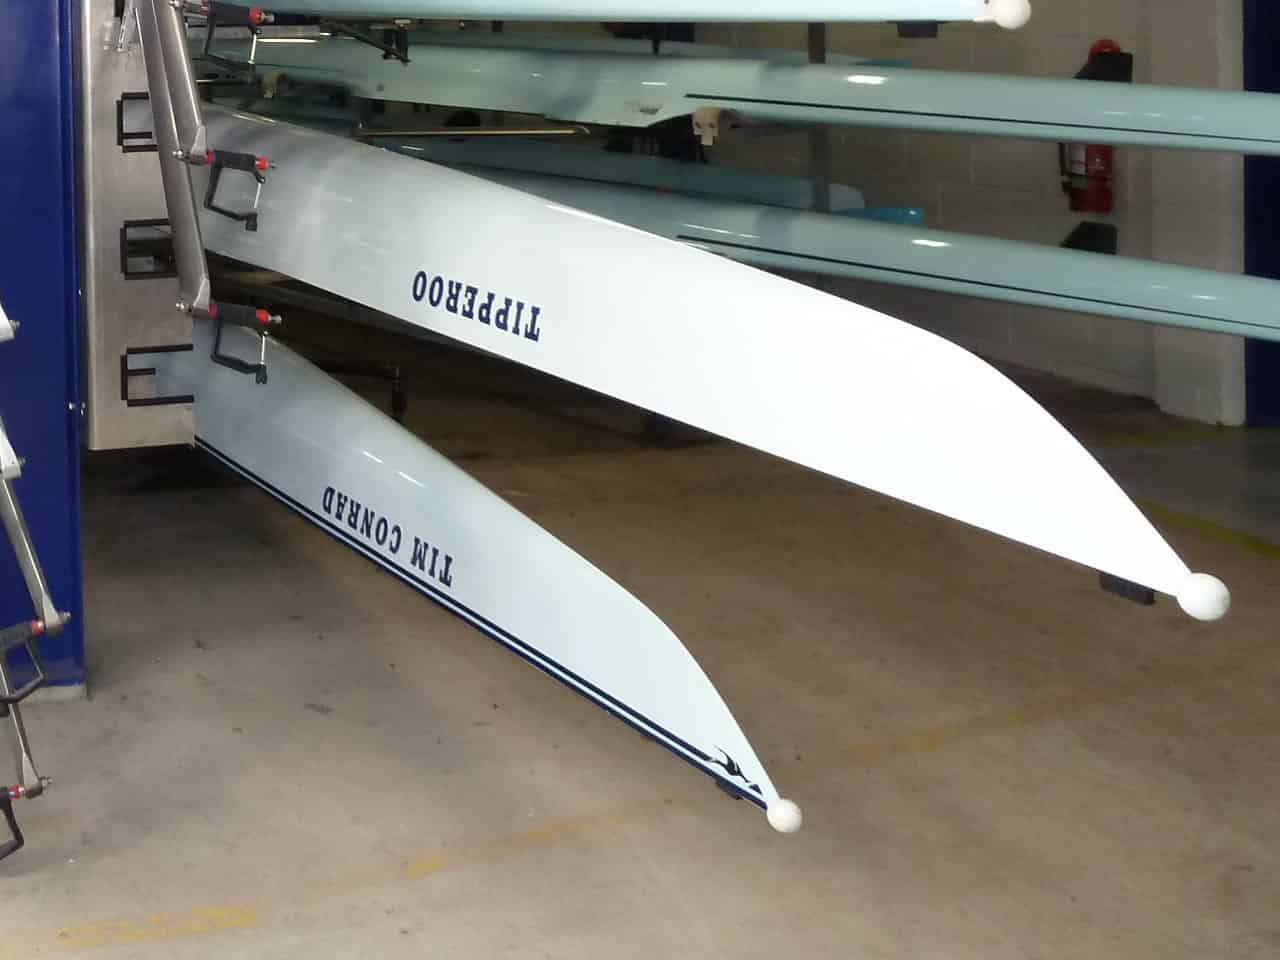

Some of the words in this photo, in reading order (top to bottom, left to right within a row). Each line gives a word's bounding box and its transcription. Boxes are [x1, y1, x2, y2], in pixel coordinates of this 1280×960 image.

[412, 270, 540, 342] TIPPEROO
[323, 486, 401, 554] CONRAD
[411, 536, 453, 587] TIM
